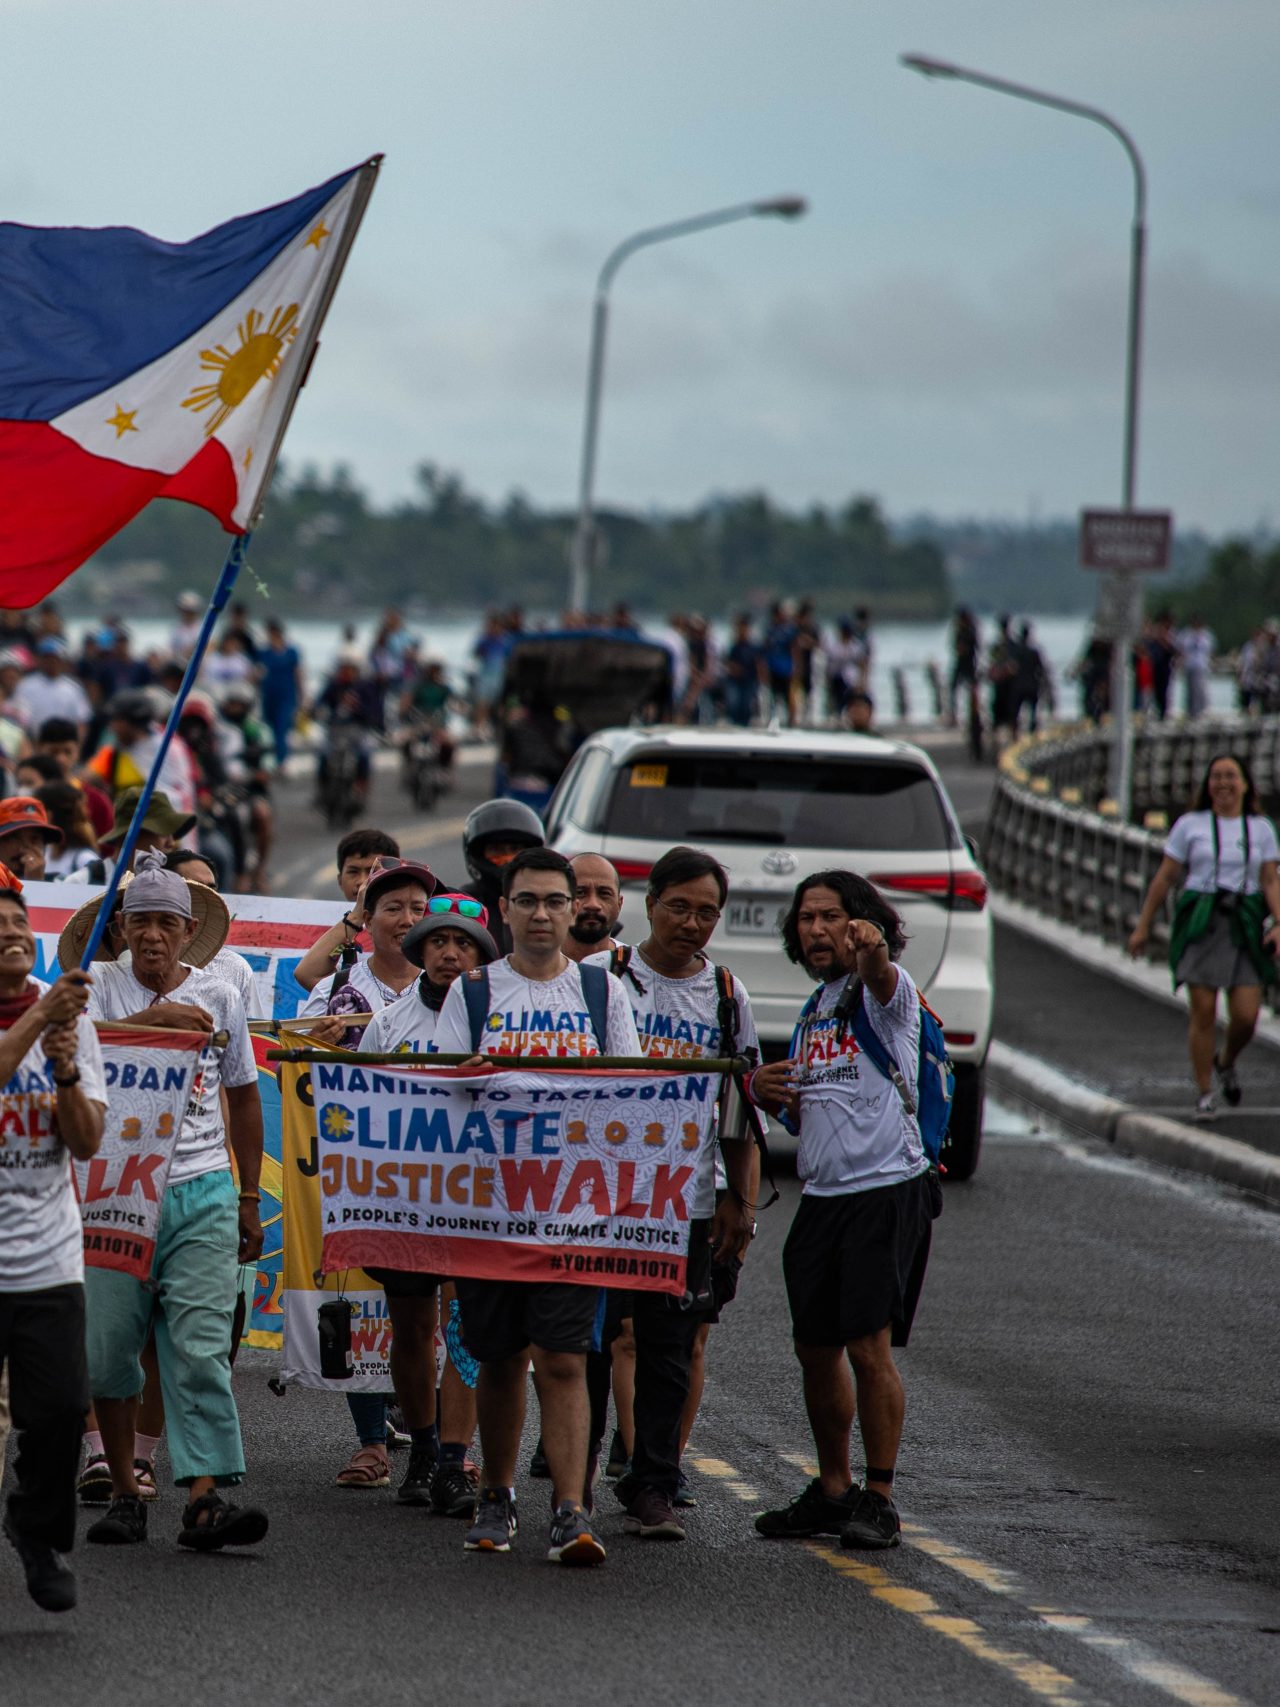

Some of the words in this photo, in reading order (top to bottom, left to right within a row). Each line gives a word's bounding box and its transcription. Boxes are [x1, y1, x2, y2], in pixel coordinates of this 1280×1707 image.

[501, 1031, 587, 1050] JUSTICE
[632, 1010, 720, 1050] LIMATE
[465, 1088, 511, 1101] TO
[121, 1112, 175, 1141] 23
[320, 1102, 561, 1154] CLIMATE
[567, 1120, 700, 1149] 2023
[322, 1154, 495, 1207] JUSTICE
[499, 1159, 695, 1221] WALK
[327, 1211, 336, 1224] A
[342, 1208, 418, 1227] PEOPLE'S
[426, 1214, 500, 1233] JOURNEY
[507, 1221, 537, 1236] FOR
[544, 1220, 608, 1238] CLIMATE
[614, 1225, 680, 1245] JUSTICE
[550, 1254, 678, 1281] #YOLANDA10TH
